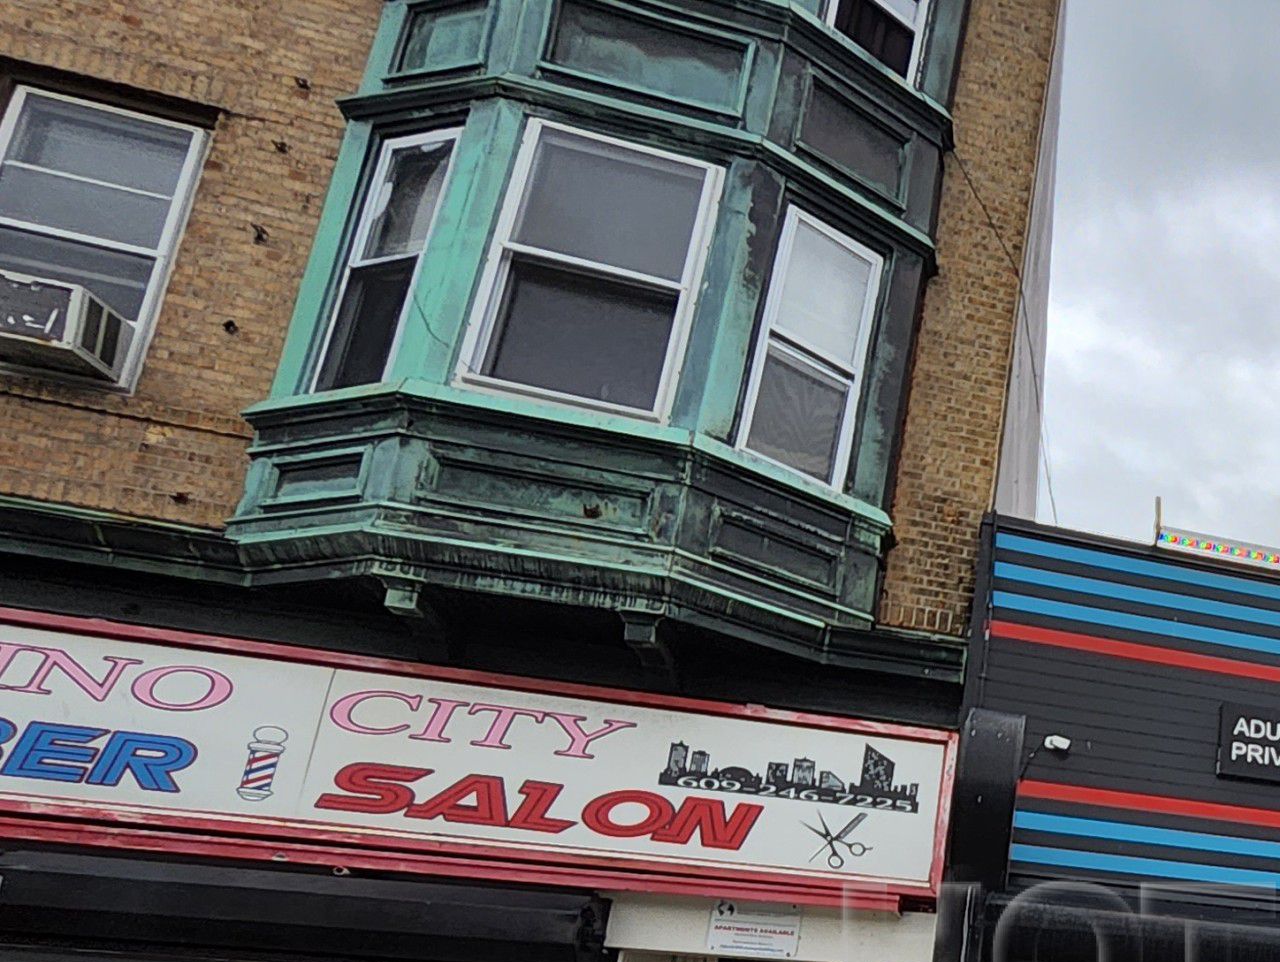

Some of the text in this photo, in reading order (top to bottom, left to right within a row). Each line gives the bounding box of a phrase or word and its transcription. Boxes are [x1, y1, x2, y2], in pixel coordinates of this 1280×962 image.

[0, 716, 199, 794] ER
[329, 690, 637, 760] CITY
[313, 761, 765, 851] SALON
[676, 775, 914, 813] 609-246-7225
